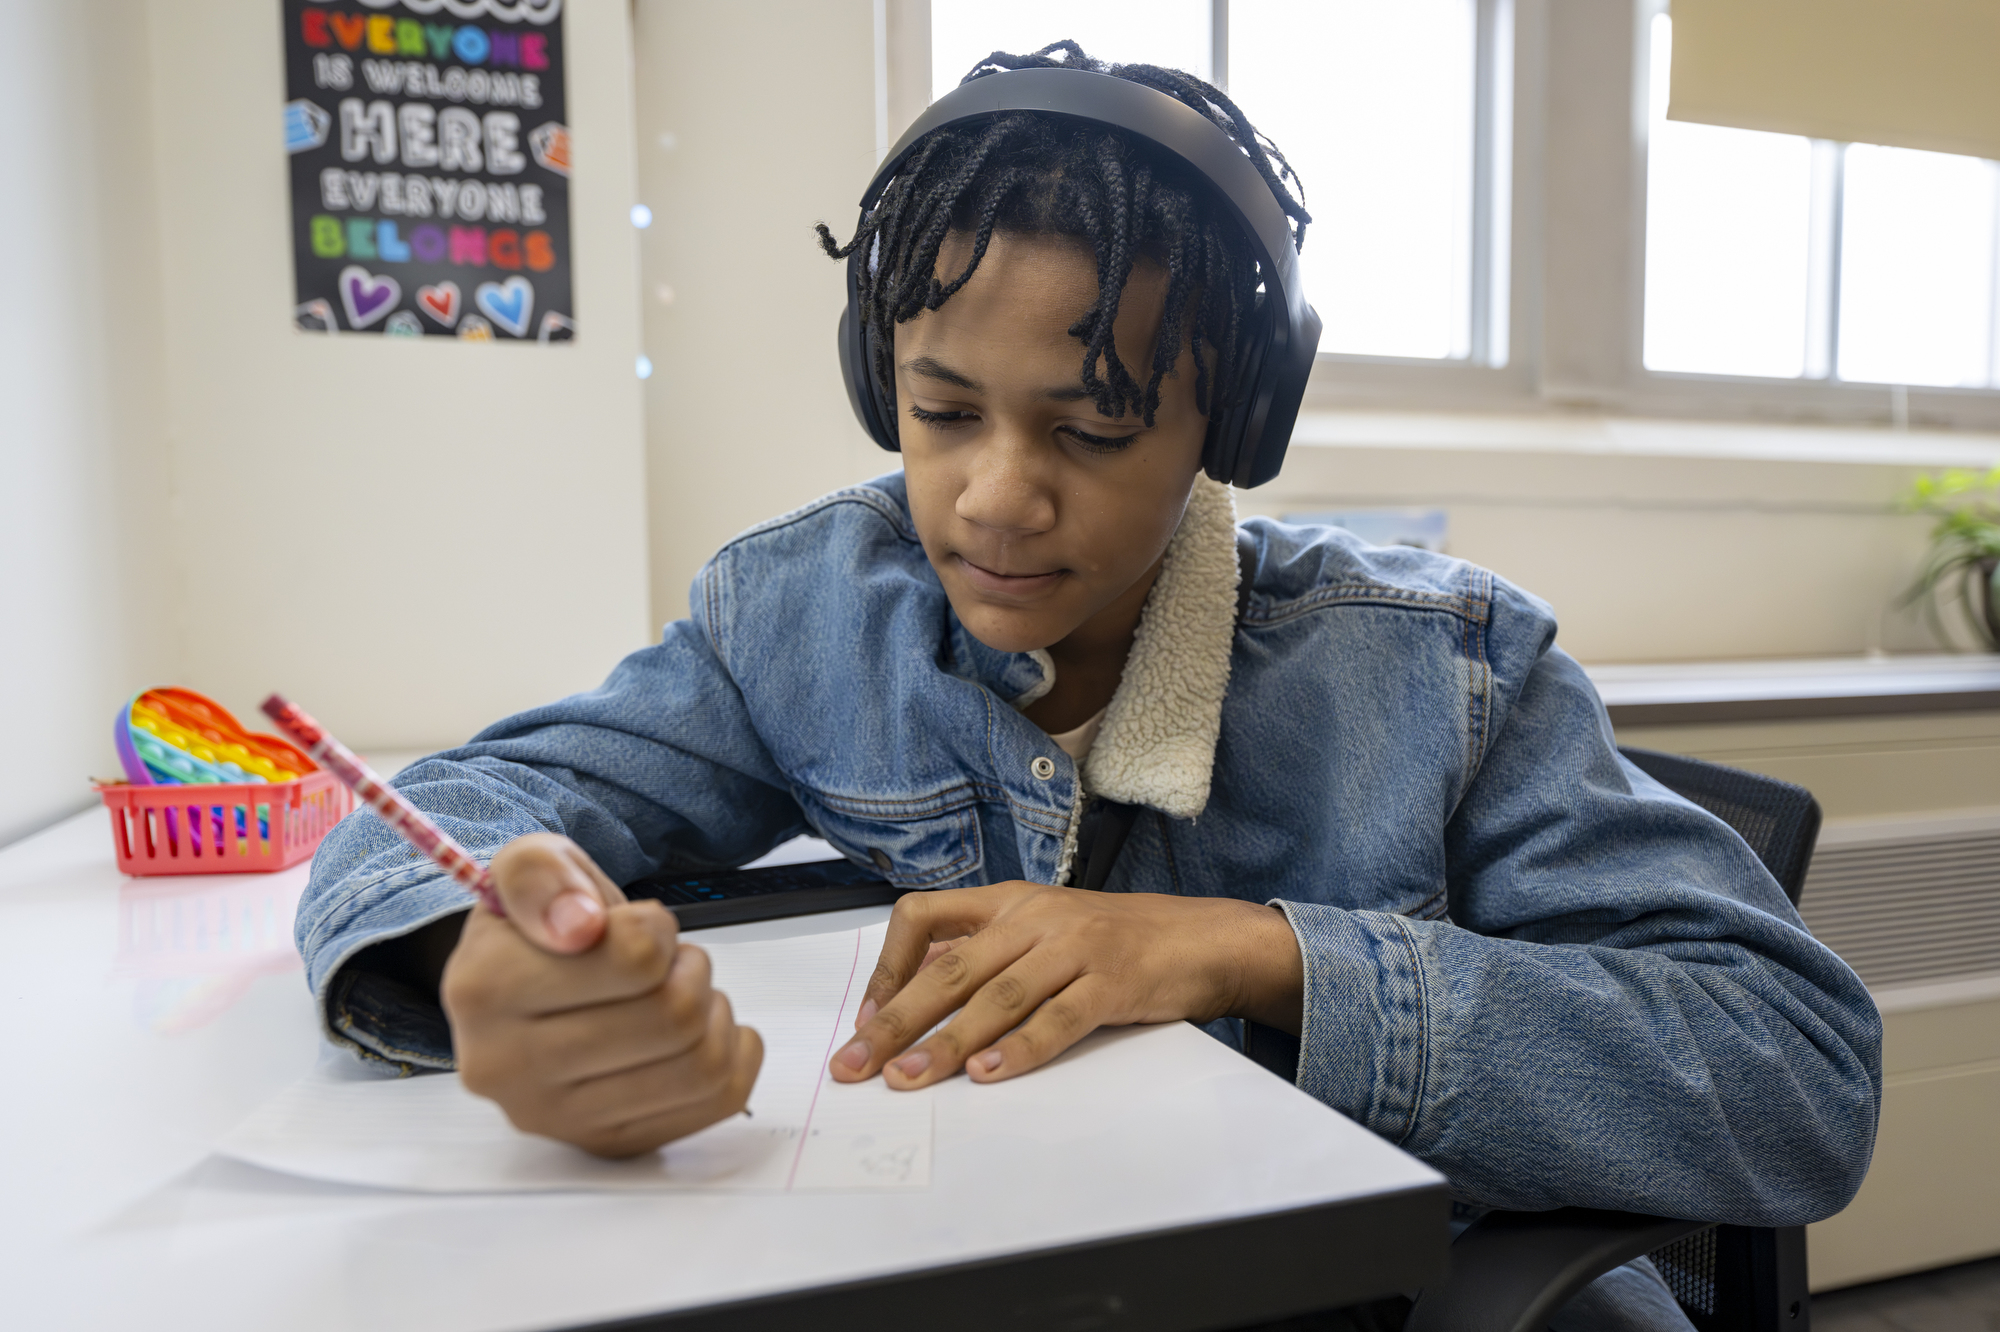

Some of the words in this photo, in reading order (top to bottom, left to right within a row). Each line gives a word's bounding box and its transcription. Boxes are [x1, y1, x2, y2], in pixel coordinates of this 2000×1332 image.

[302, 9, 548, 71] EVERYONE
[313, 53, 353, 91] IS
[361, 58, 542, 109] WELCOME
[338, 97, 526, 175] HERE
[320, 167, 546, 226] EVERYONE
[310, 214, 556, 273] BELONGS
